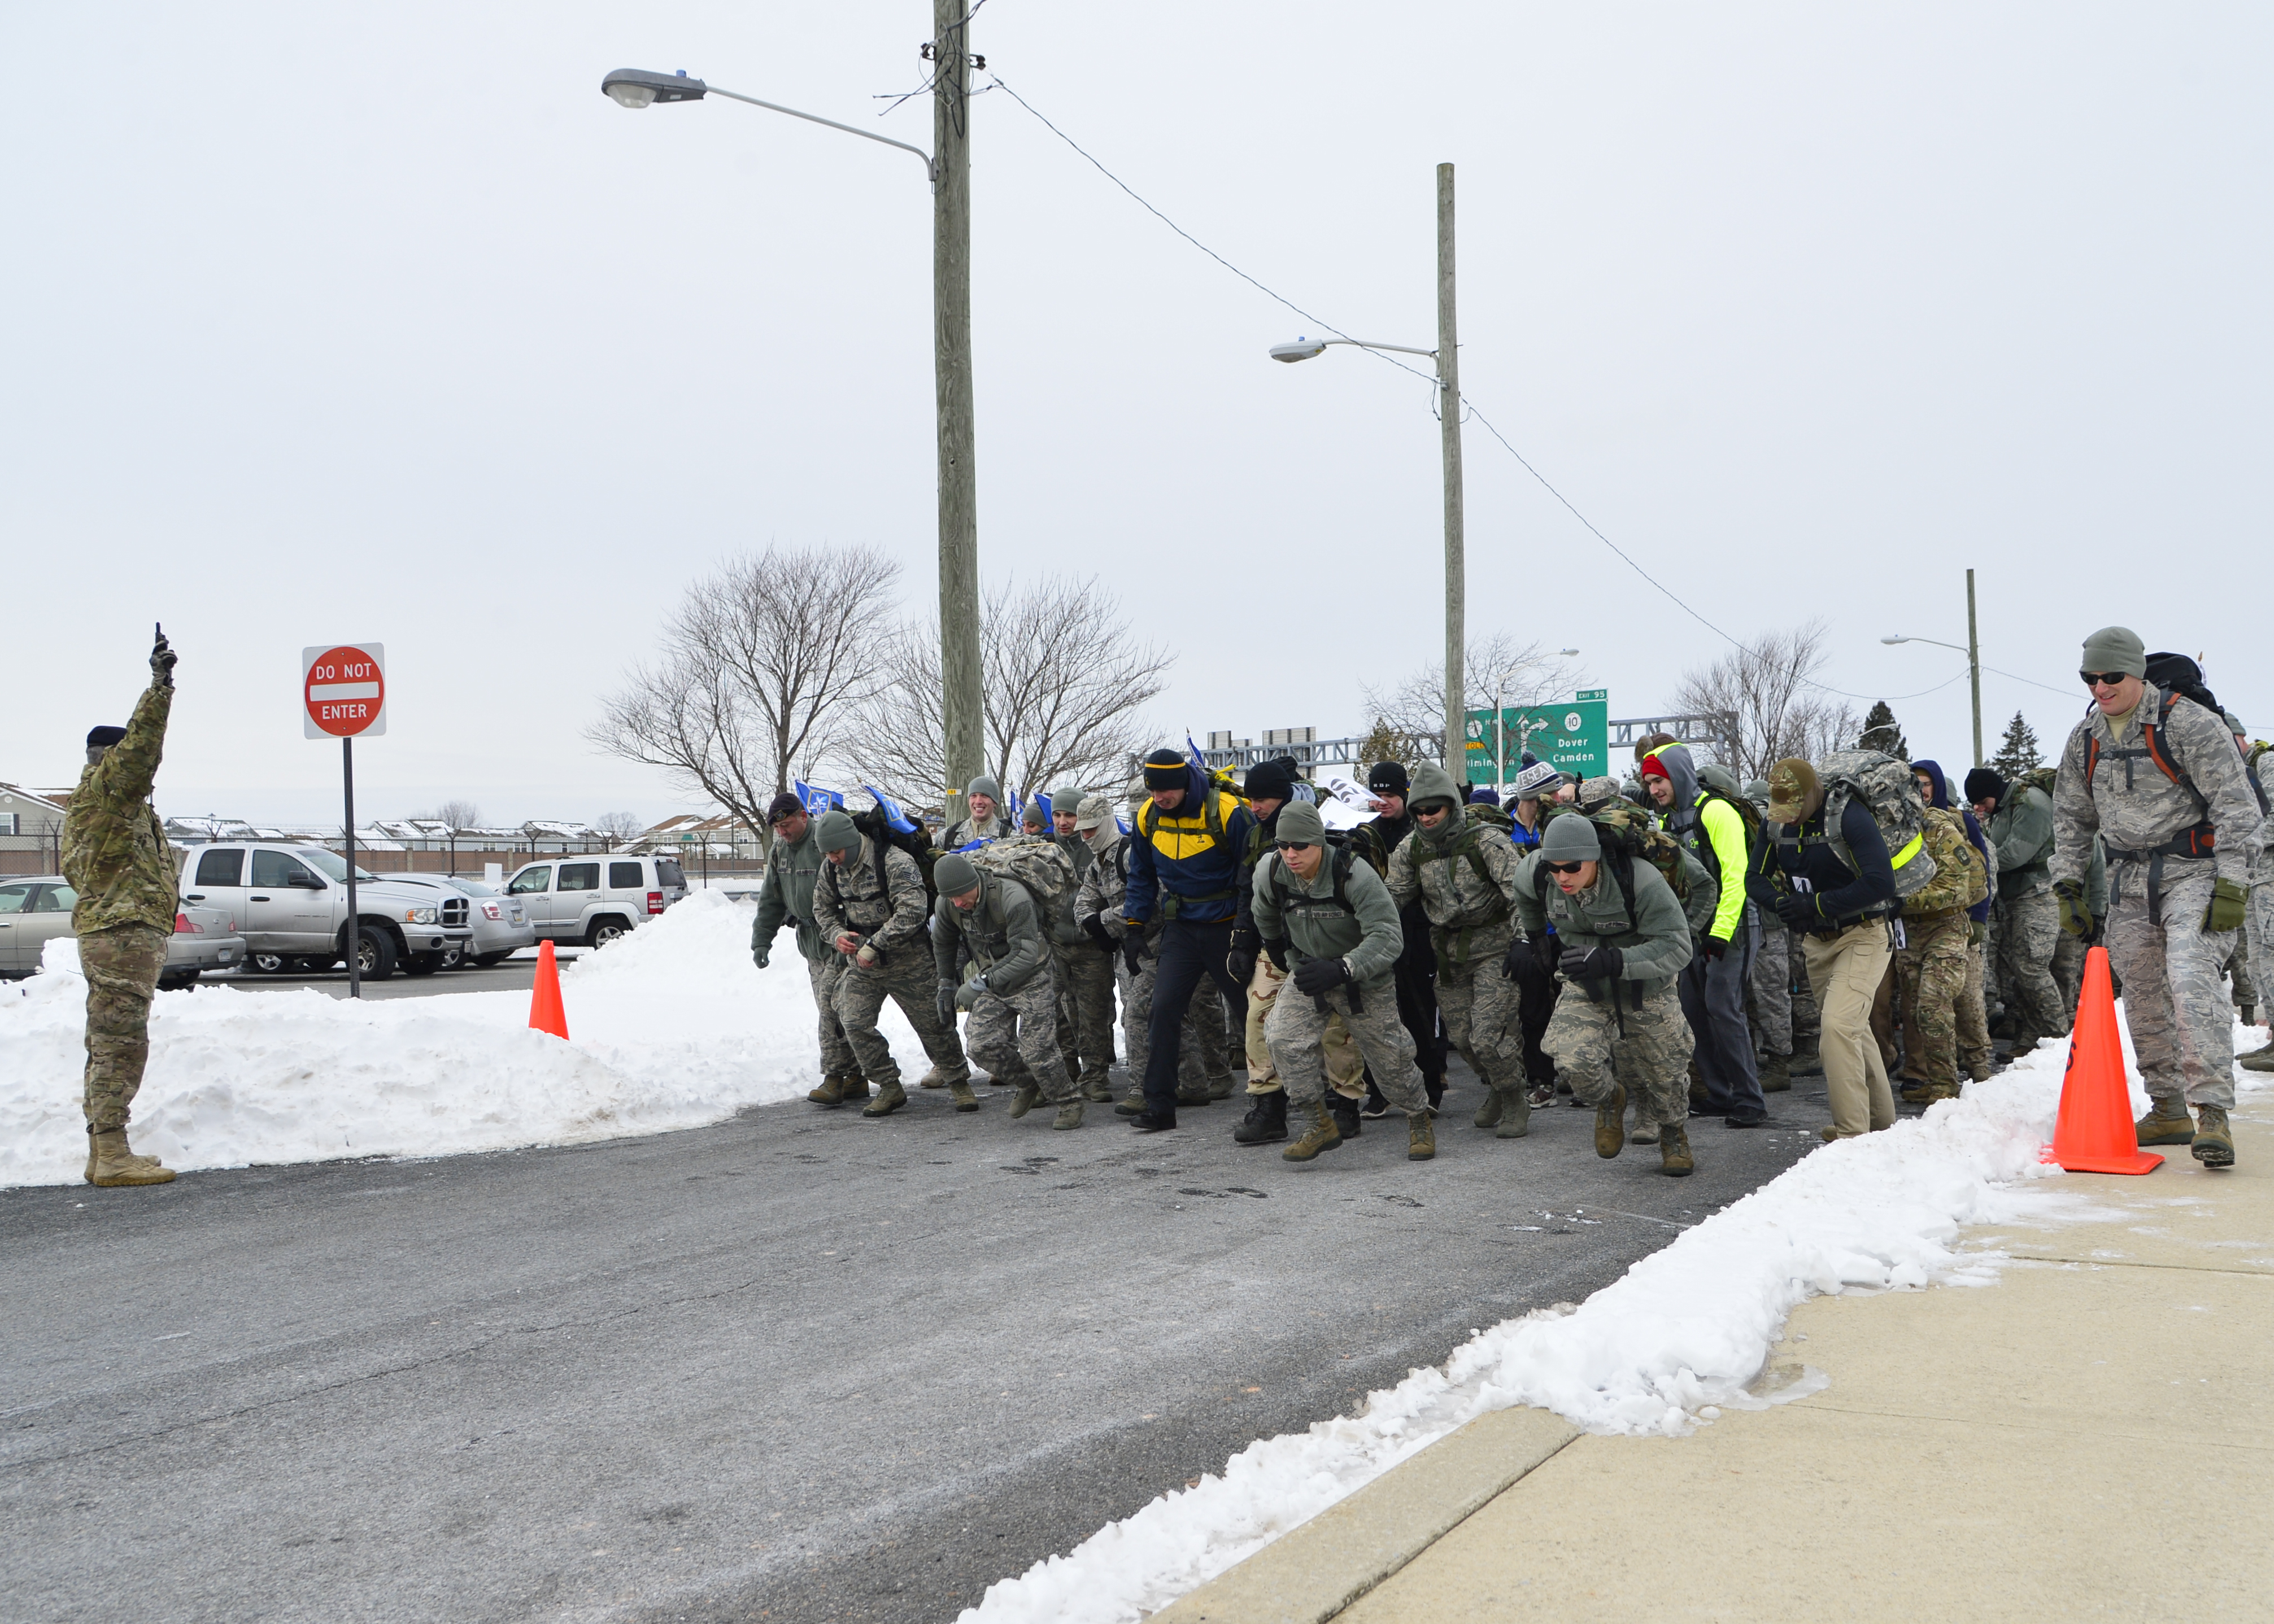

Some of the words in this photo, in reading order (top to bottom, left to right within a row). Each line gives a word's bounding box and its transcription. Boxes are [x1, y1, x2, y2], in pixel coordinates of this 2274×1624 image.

[316, 665, 336, 680] DO
[343, 663, 372, 678] NOT
[322, 704, 367, 719] ENTER
[1568, 717, 1578, 727] 10
[1558, 738, 1588, 748] Dover
[1553, 752, 1595, 763] Camden
